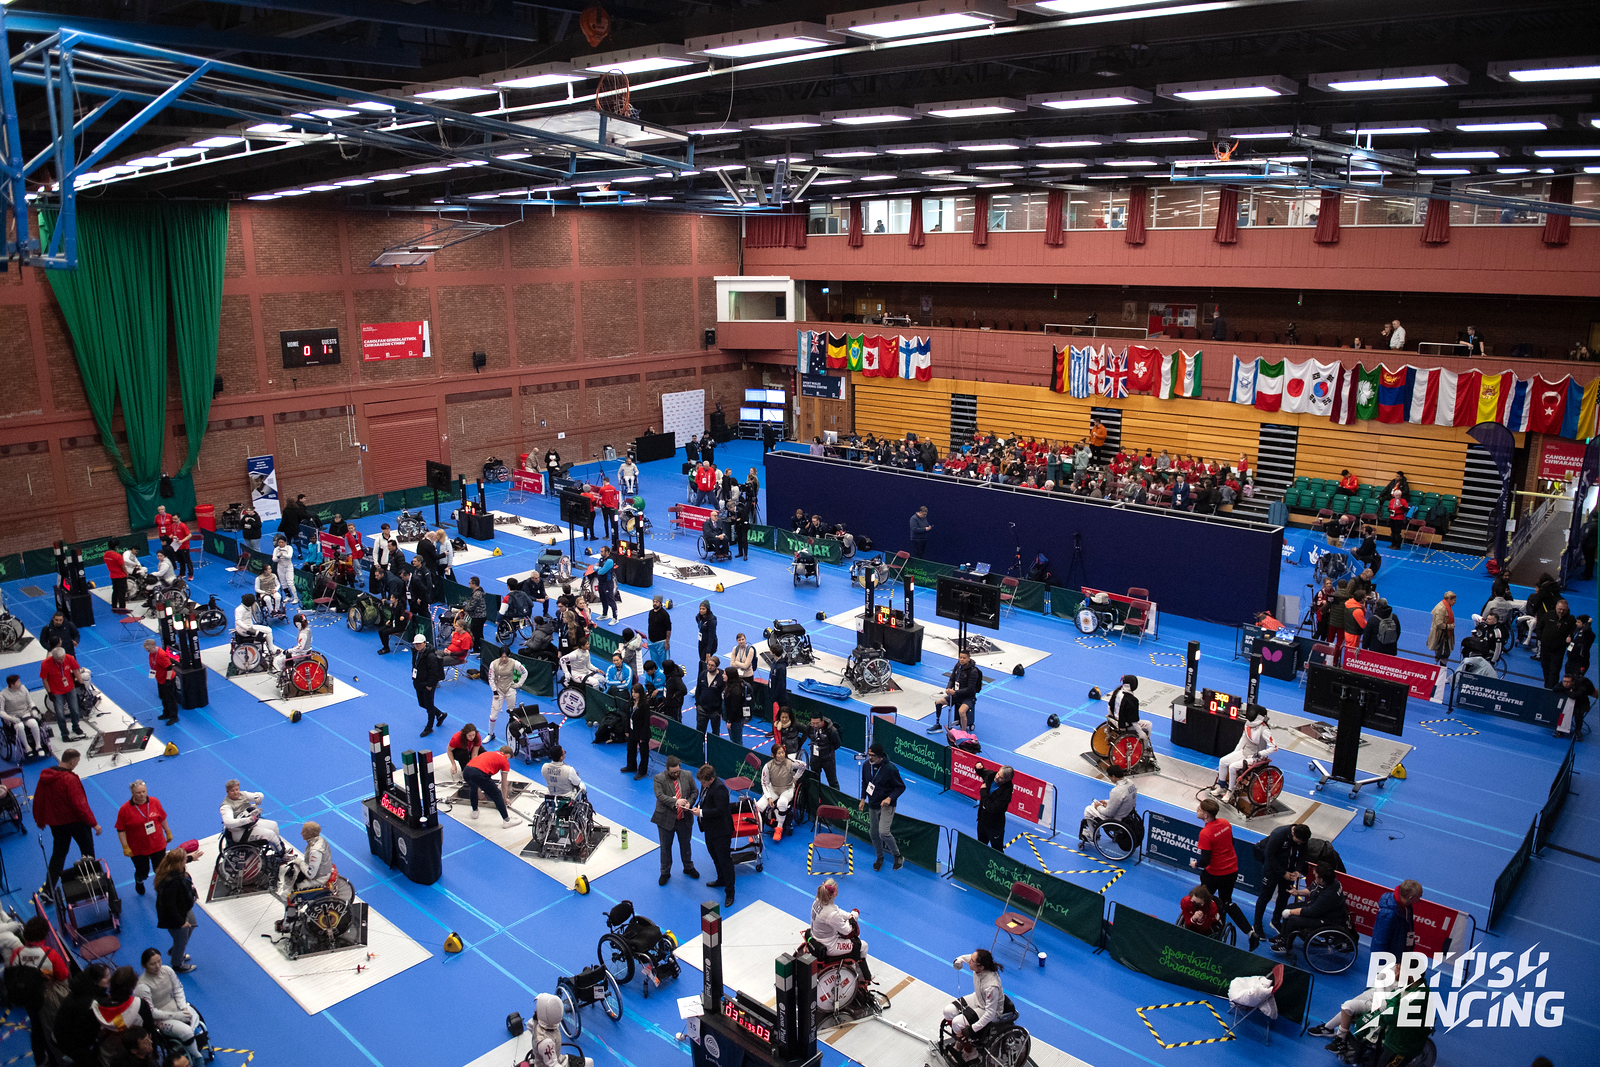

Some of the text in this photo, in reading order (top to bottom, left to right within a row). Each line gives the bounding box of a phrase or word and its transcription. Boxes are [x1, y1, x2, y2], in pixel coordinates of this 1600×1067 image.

[303, 345, 311, 356] 0
[1545, 454, 1580, 463] CANOLFAN
[1346, 662, 1408, 680] CHWARAEON CYMRU
[1347, 658, 1427, 680] CANOLFAN GENEDLAETHOL
[1215, 692, 1229, 702] 3:00
[1461, 689, 1524, 706] NATIONAL CENTRE
[1462, 683, 1508, 697] SPORT WALES
[1210, 701, 1217, 712] 0
[1230, 706, 1237, 717] 0
[895, 736, 935, 760] sportwales
[1151, 826, 1199, 846] SPORT WALE
[1151, 833, 1191, 852] NATIONAL
[1162, 946, 1222, 974] sportwales
[725, 1005, 738, 1021] 03
[690, 1022, 696, 1031] 15
[756, 1025, 770, 1041] 03
